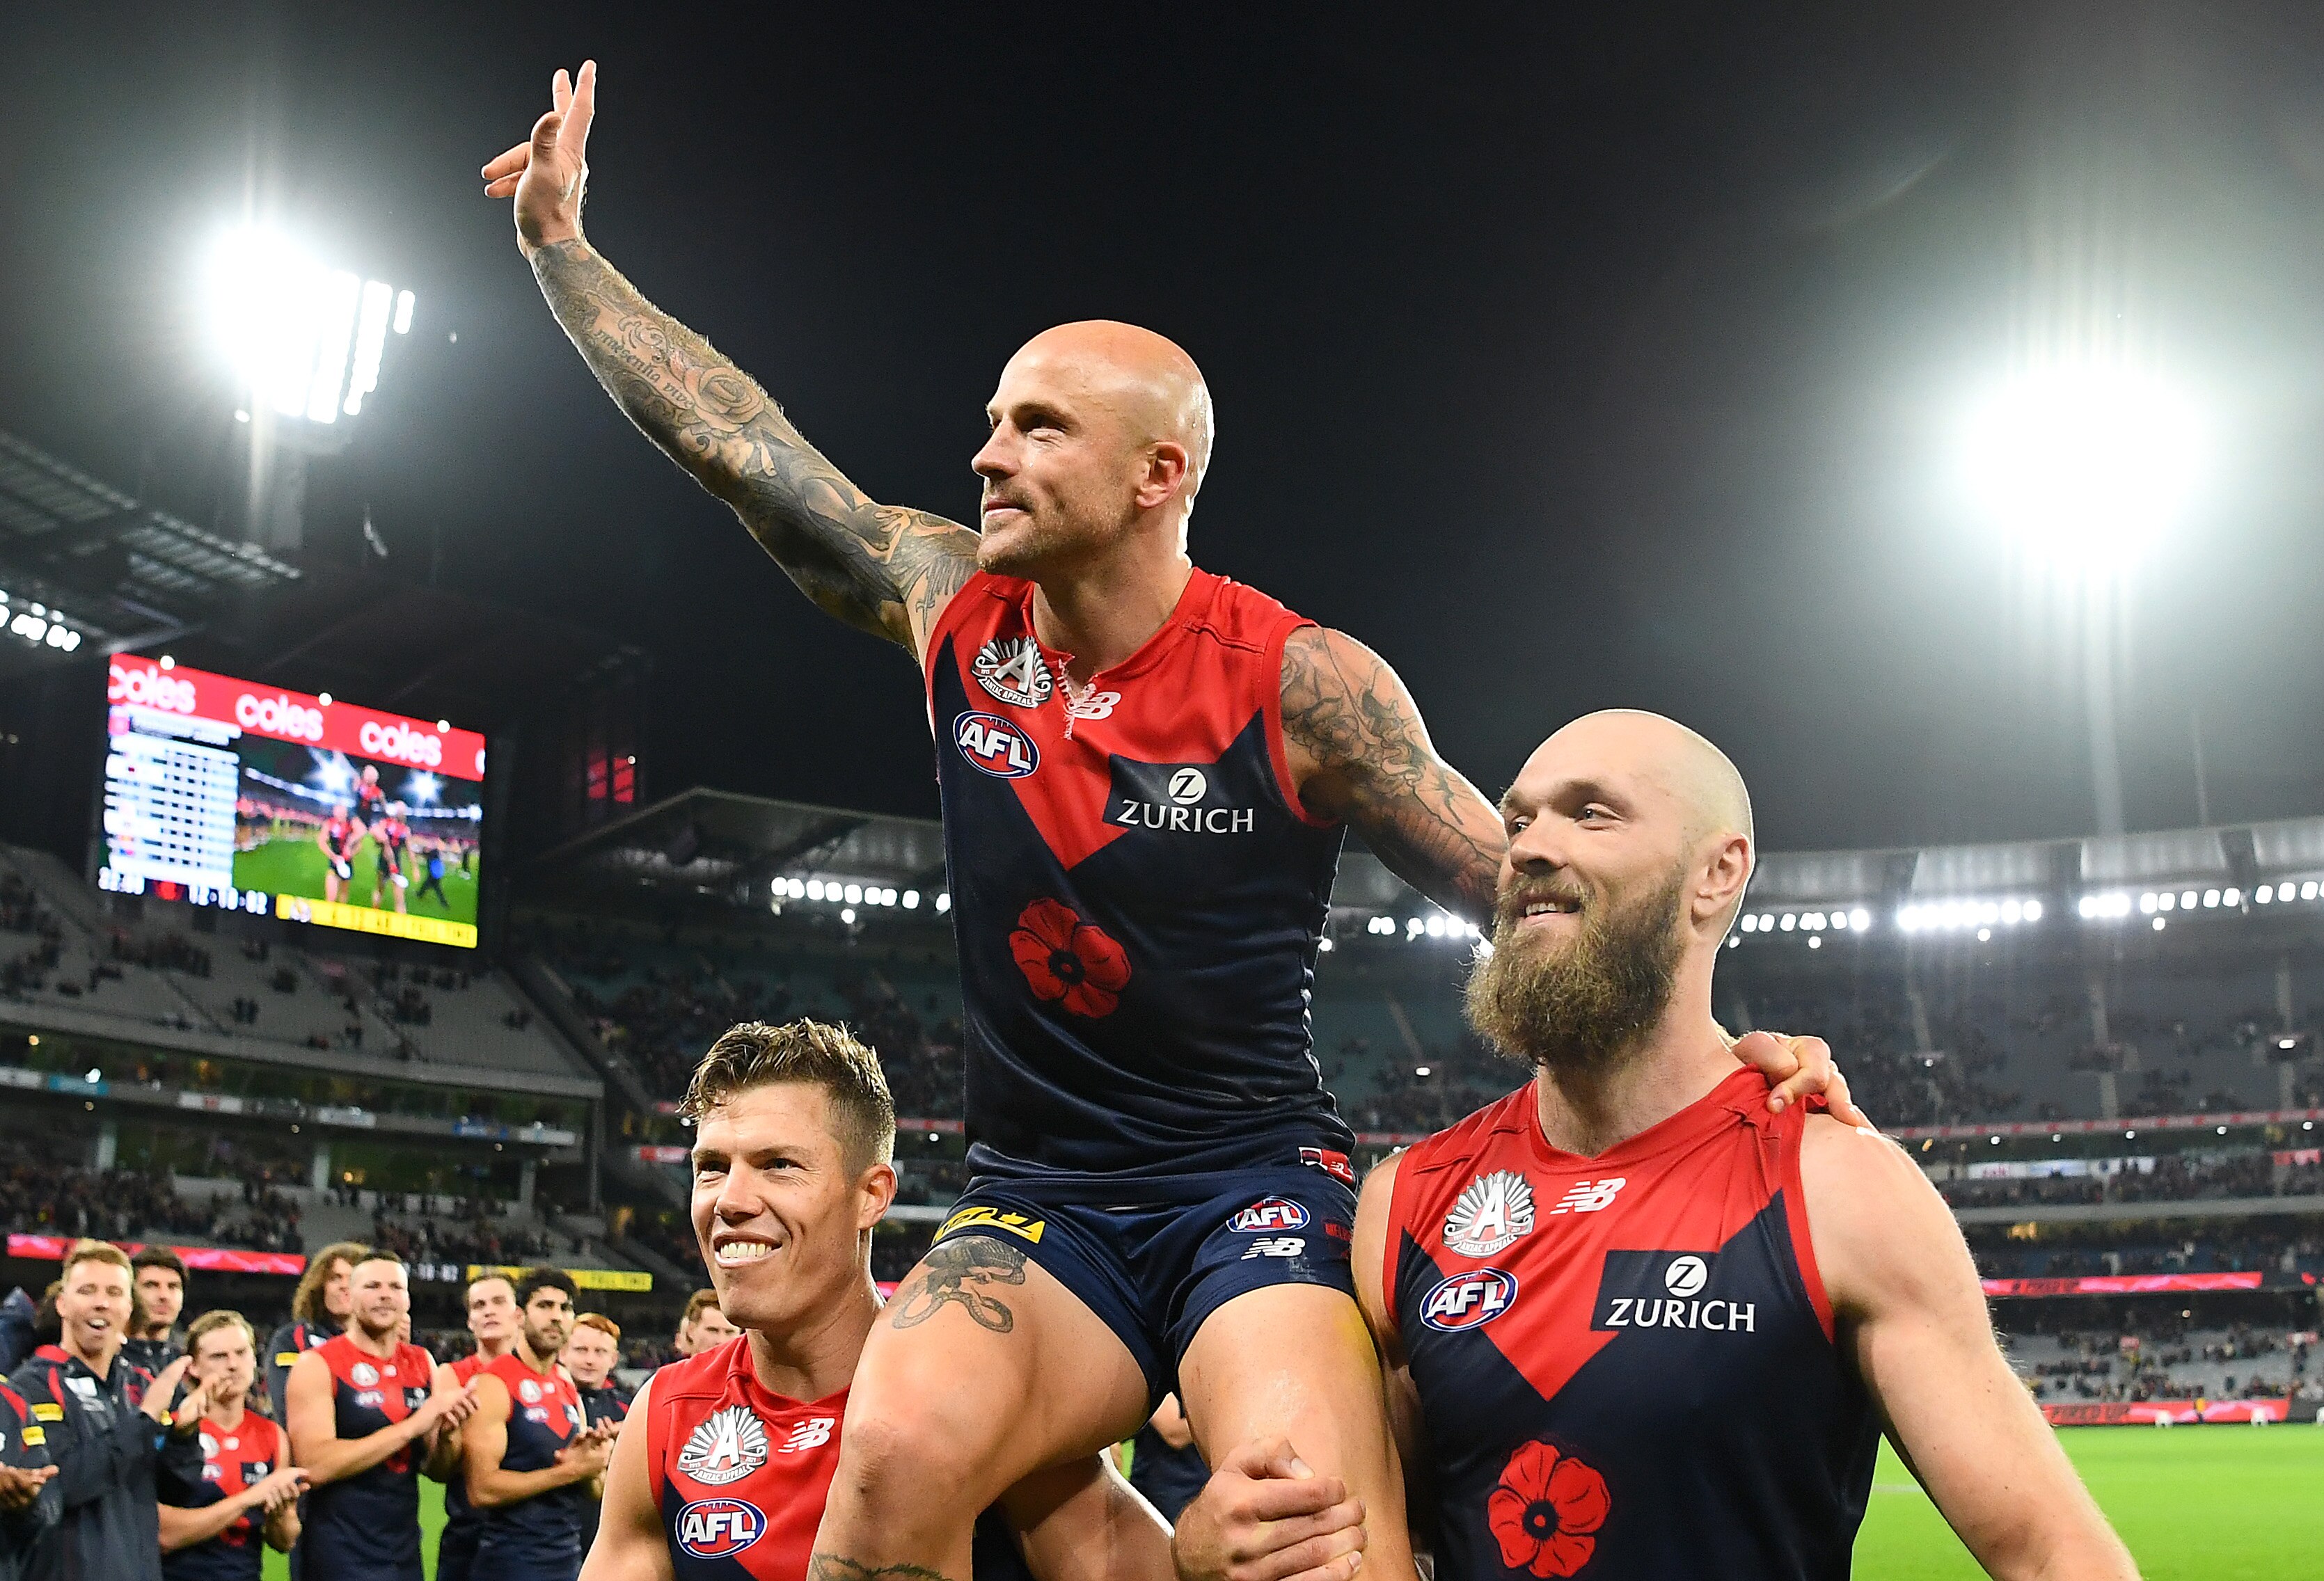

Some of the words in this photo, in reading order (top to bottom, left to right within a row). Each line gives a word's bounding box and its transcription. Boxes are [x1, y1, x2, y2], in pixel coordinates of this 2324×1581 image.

[984, 678, 1003, 697] ANZAC
[1002, 691, 1032, 706] APPEAL
[235, 694, 324, 741] coles
[359, 722, 443, 767] coles
[958, 720, 1031, 772] AFL
[1116, 799, 1254, 834] ZURICH
[1237, 1205, 1304, 1230] AFL
[1462, 1242, 1484, 1253] ANZAC
[1427, 1280, 1505, 1319] AFL
[1605, 1298, 1755, 1332] ZURICH
[697, 1471, 721, 1481] ANZAC
[722, 1465, 748, 1480] APPEAL
[683, 1511, 756, 1543] AFL
